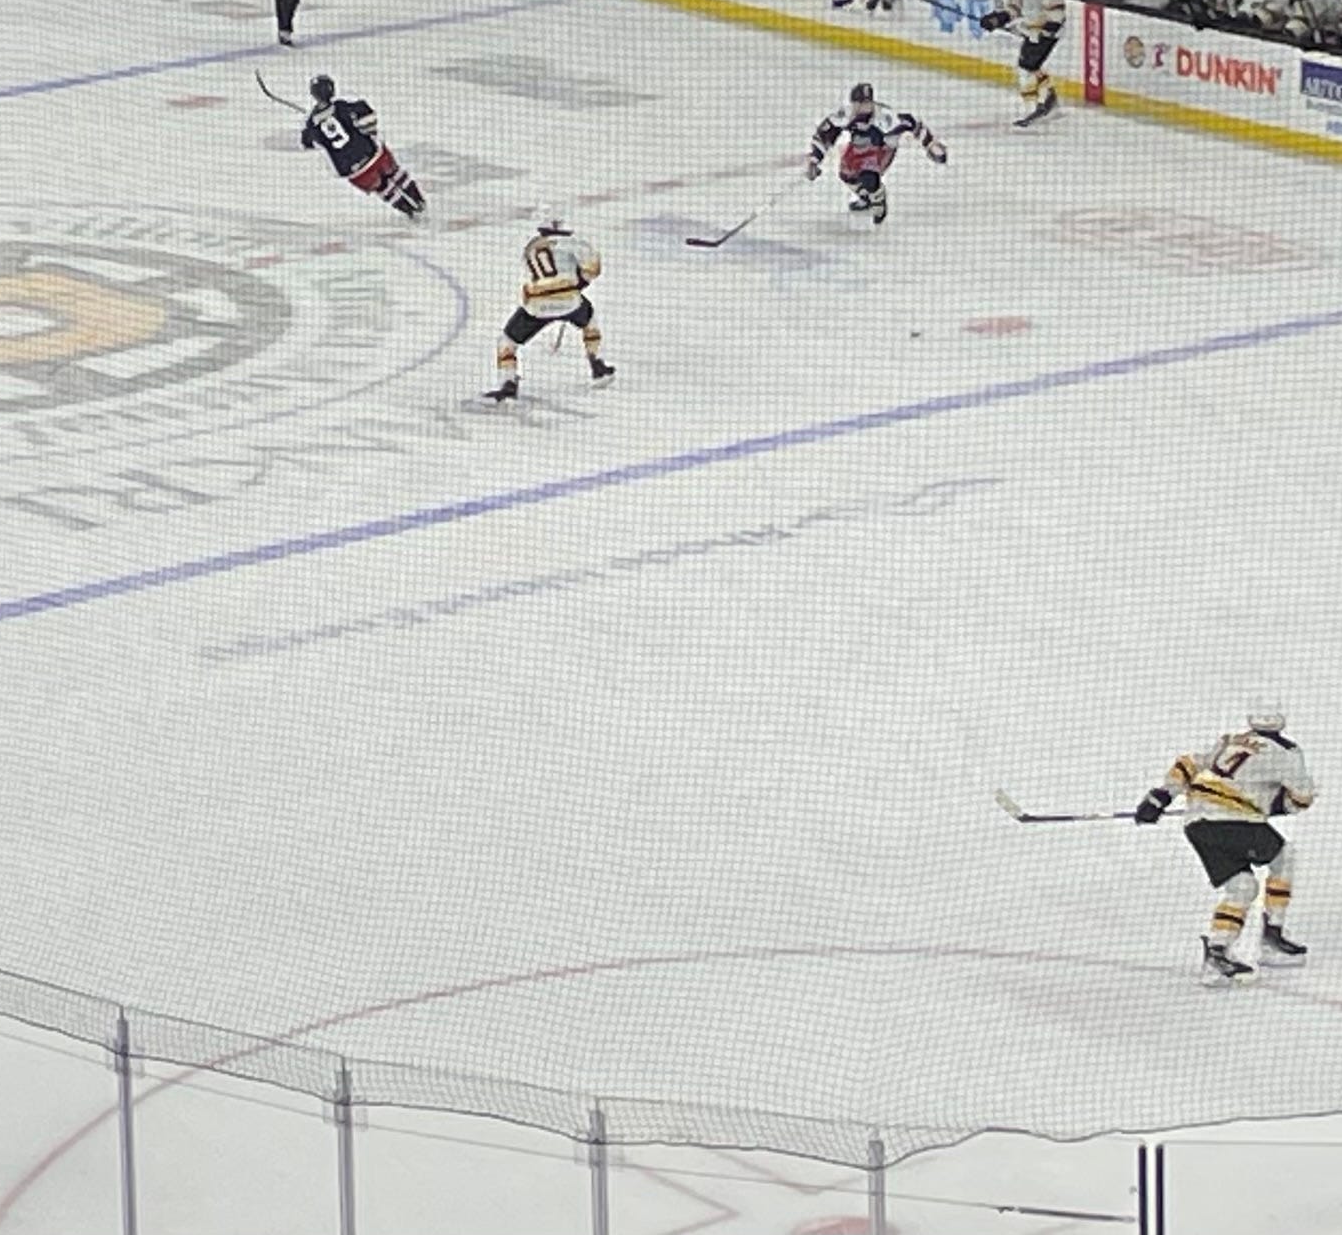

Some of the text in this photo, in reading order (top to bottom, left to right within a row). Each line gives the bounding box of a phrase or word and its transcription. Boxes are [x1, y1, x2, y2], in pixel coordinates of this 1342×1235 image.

[1175, 44, 1284, 96] DUNKIN'
[319, 116, 350, 149] 9
[526, 246, 558, 283] 10
